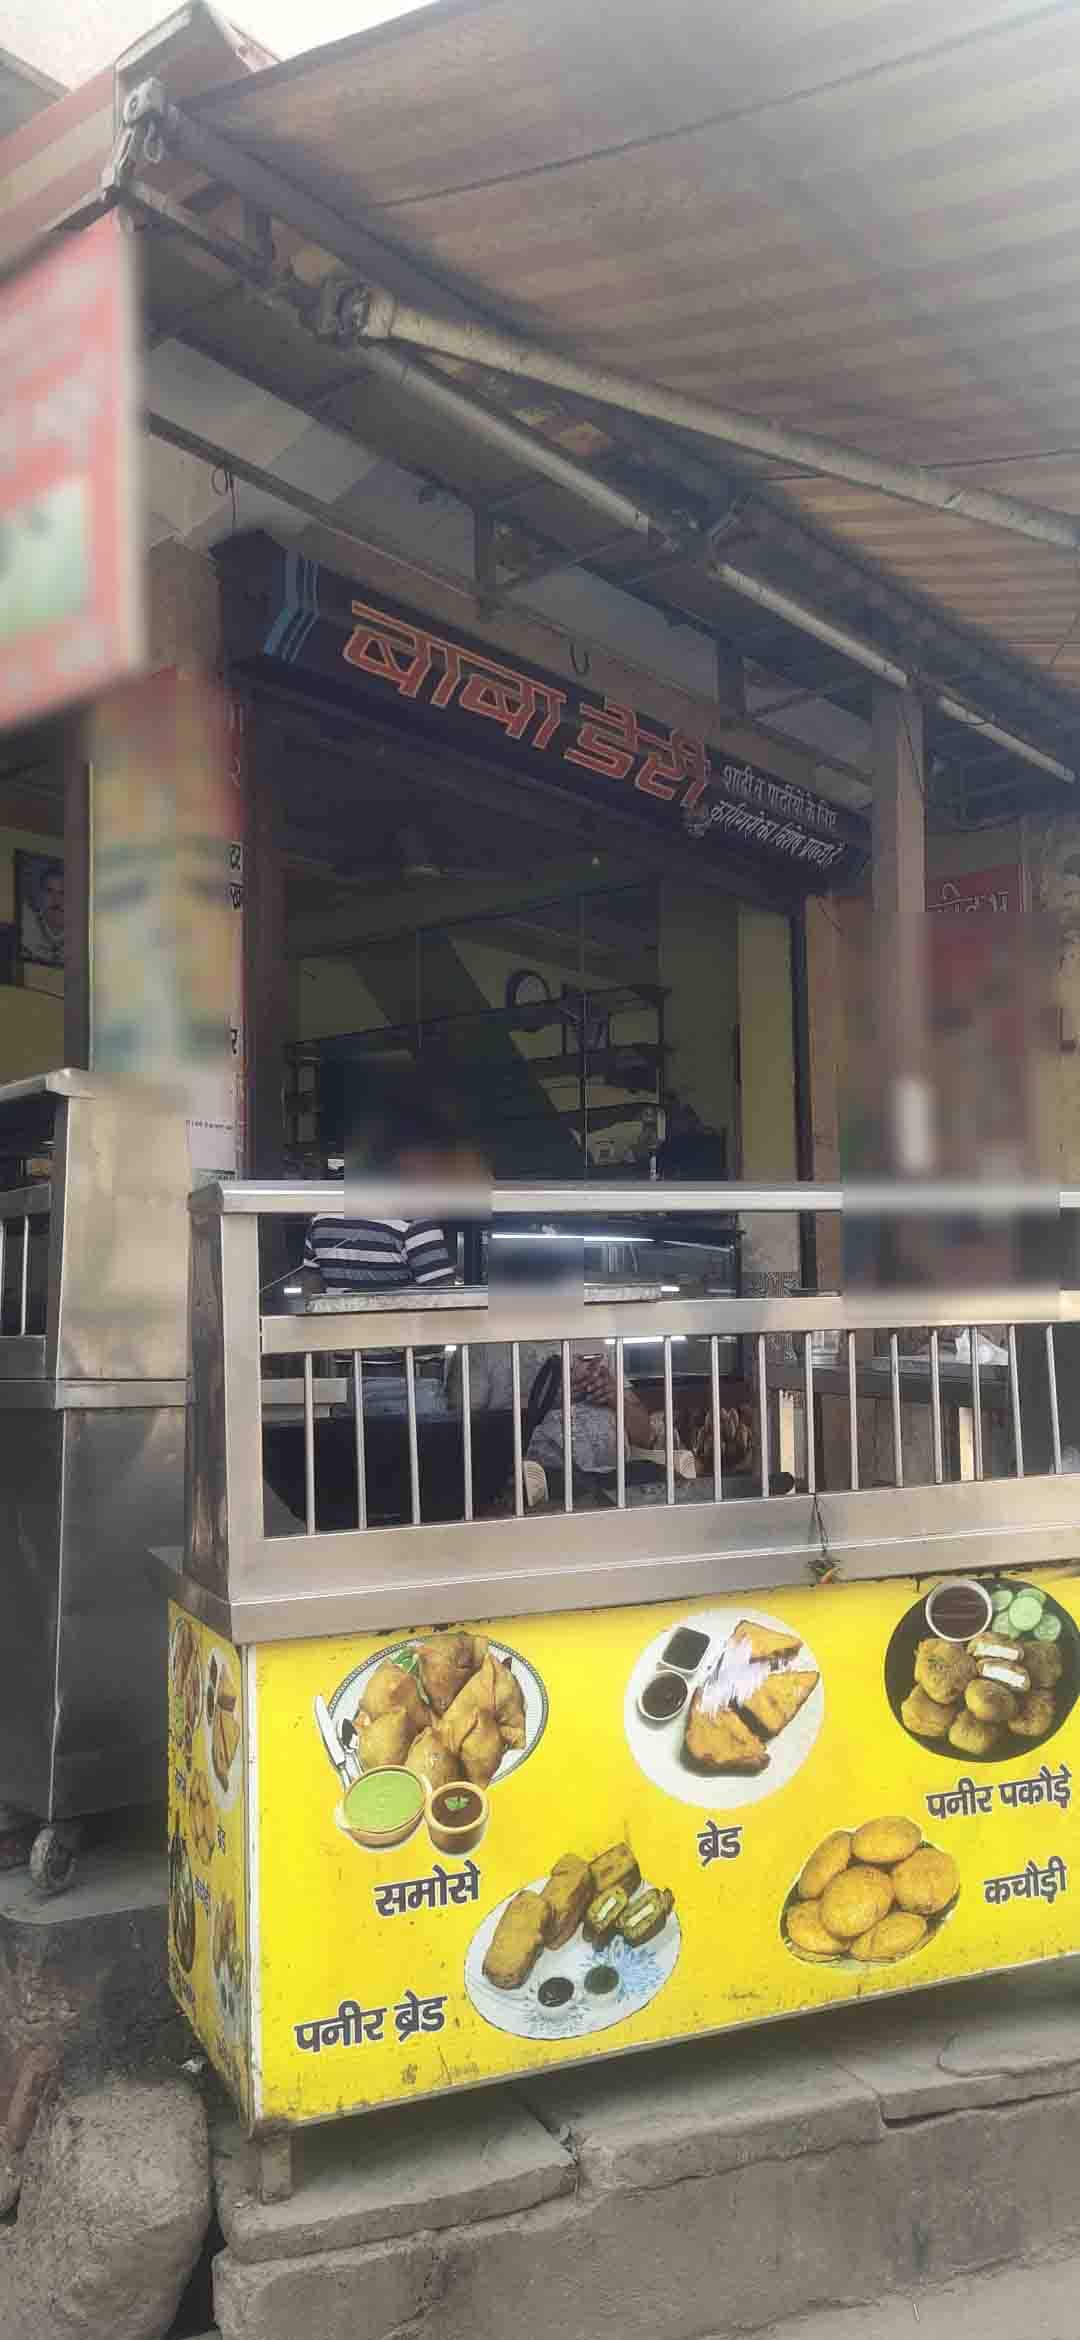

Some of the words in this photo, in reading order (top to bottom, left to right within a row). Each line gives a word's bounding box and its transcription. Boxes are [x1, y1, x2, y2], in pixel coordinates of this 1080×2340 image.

[343, 599, 568, 750] बाबा
[563, 698, 711, 808] डेरी
[926, 1777, 994, 1820] पनीर
[998, 1764, 1072, 1809] पकौड़े
[696, 1820, 743, 1868] ब्रेड
[373, 1859, 481, 1917] समोसे
[983, 1855, 1068, 1905] कचौड़ी
[294, 2000, 388, 2053] पनीर
[394, 1989, 448, 2043] ब्रेड
